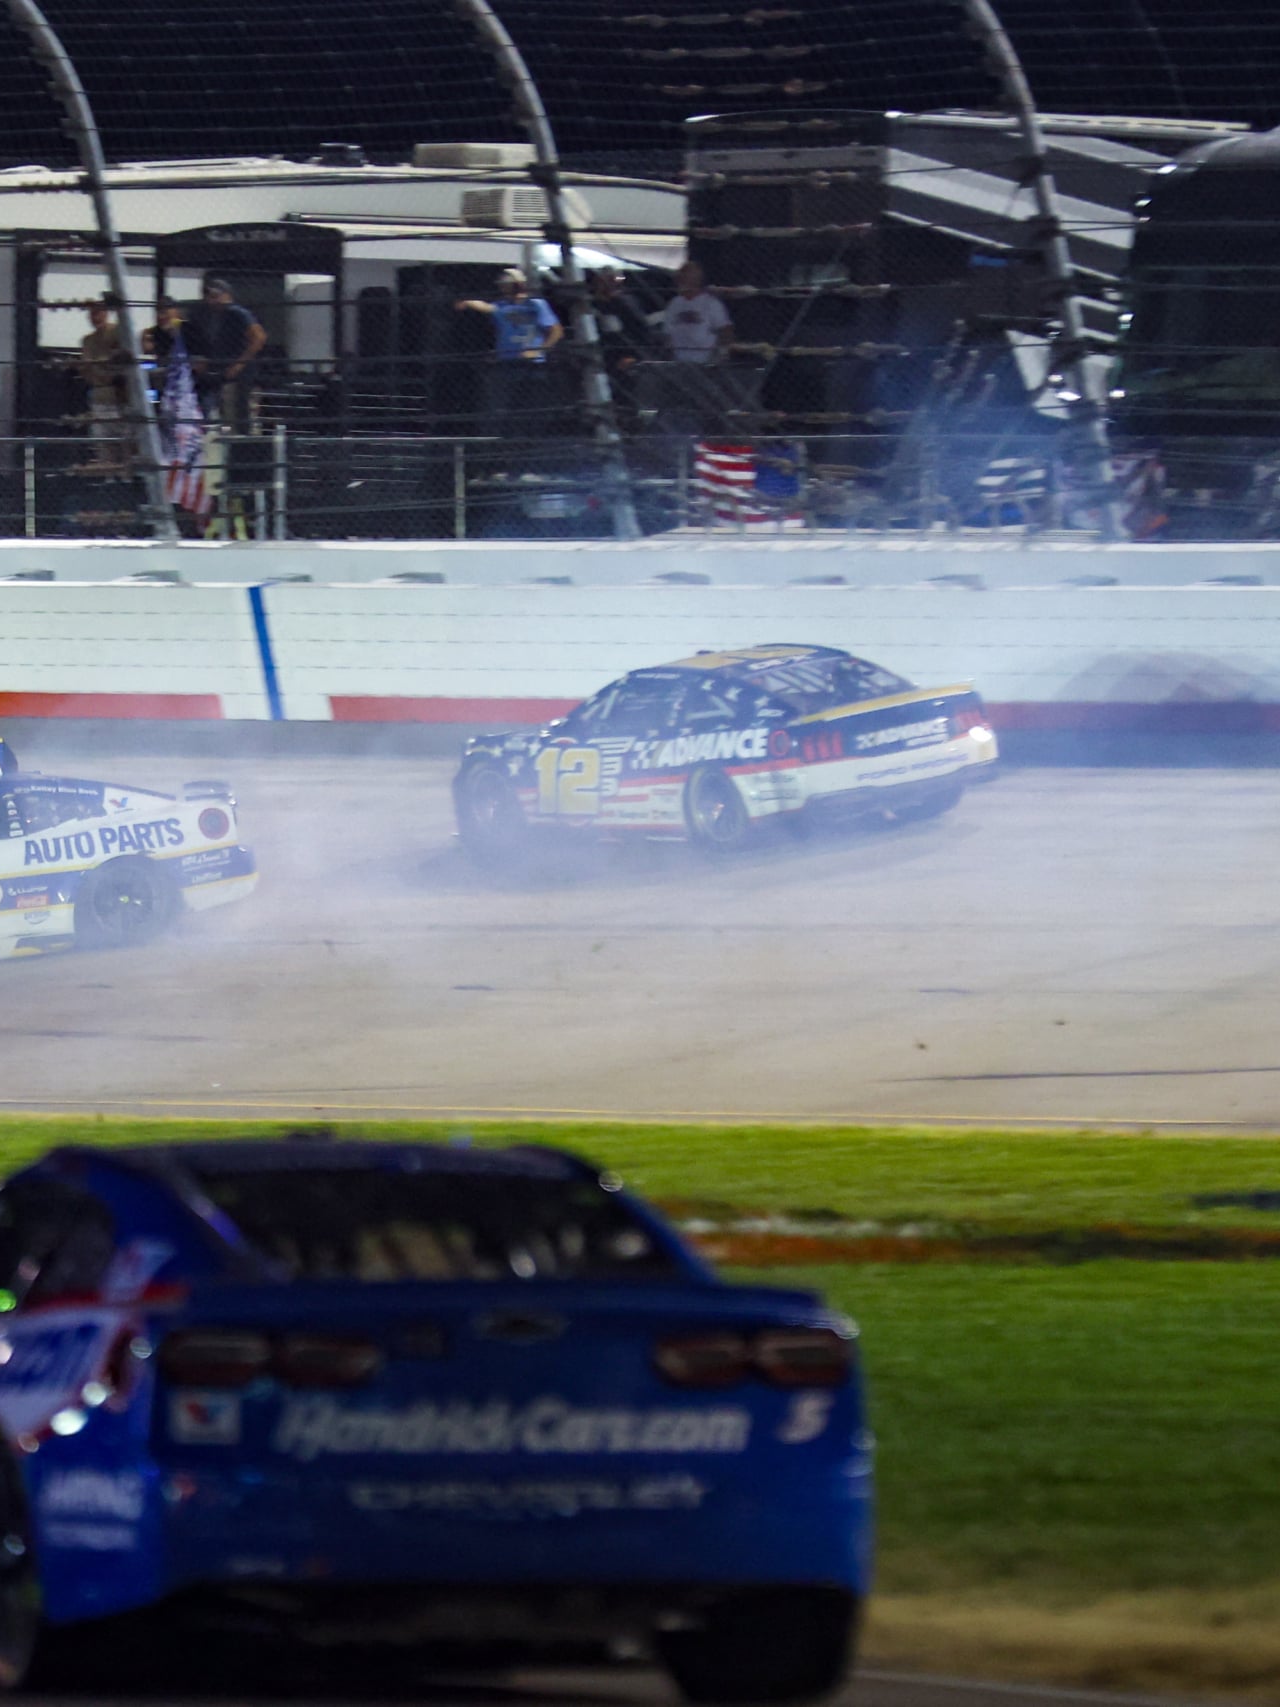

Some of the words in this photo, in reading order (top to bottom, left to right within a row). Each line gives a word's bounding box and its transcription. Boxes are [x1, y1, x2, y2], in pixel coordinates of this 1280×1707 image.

[655, 727, 769, 768] ADVANCE
[534, 746, 600, 814] 12
[24, 831, 96, 866] AUTO
[98, 817, 185, 854] PARTS
[272, 1394, 753, 1459] HendrickCars.com
[778, 1390, 834, 1444] 5
